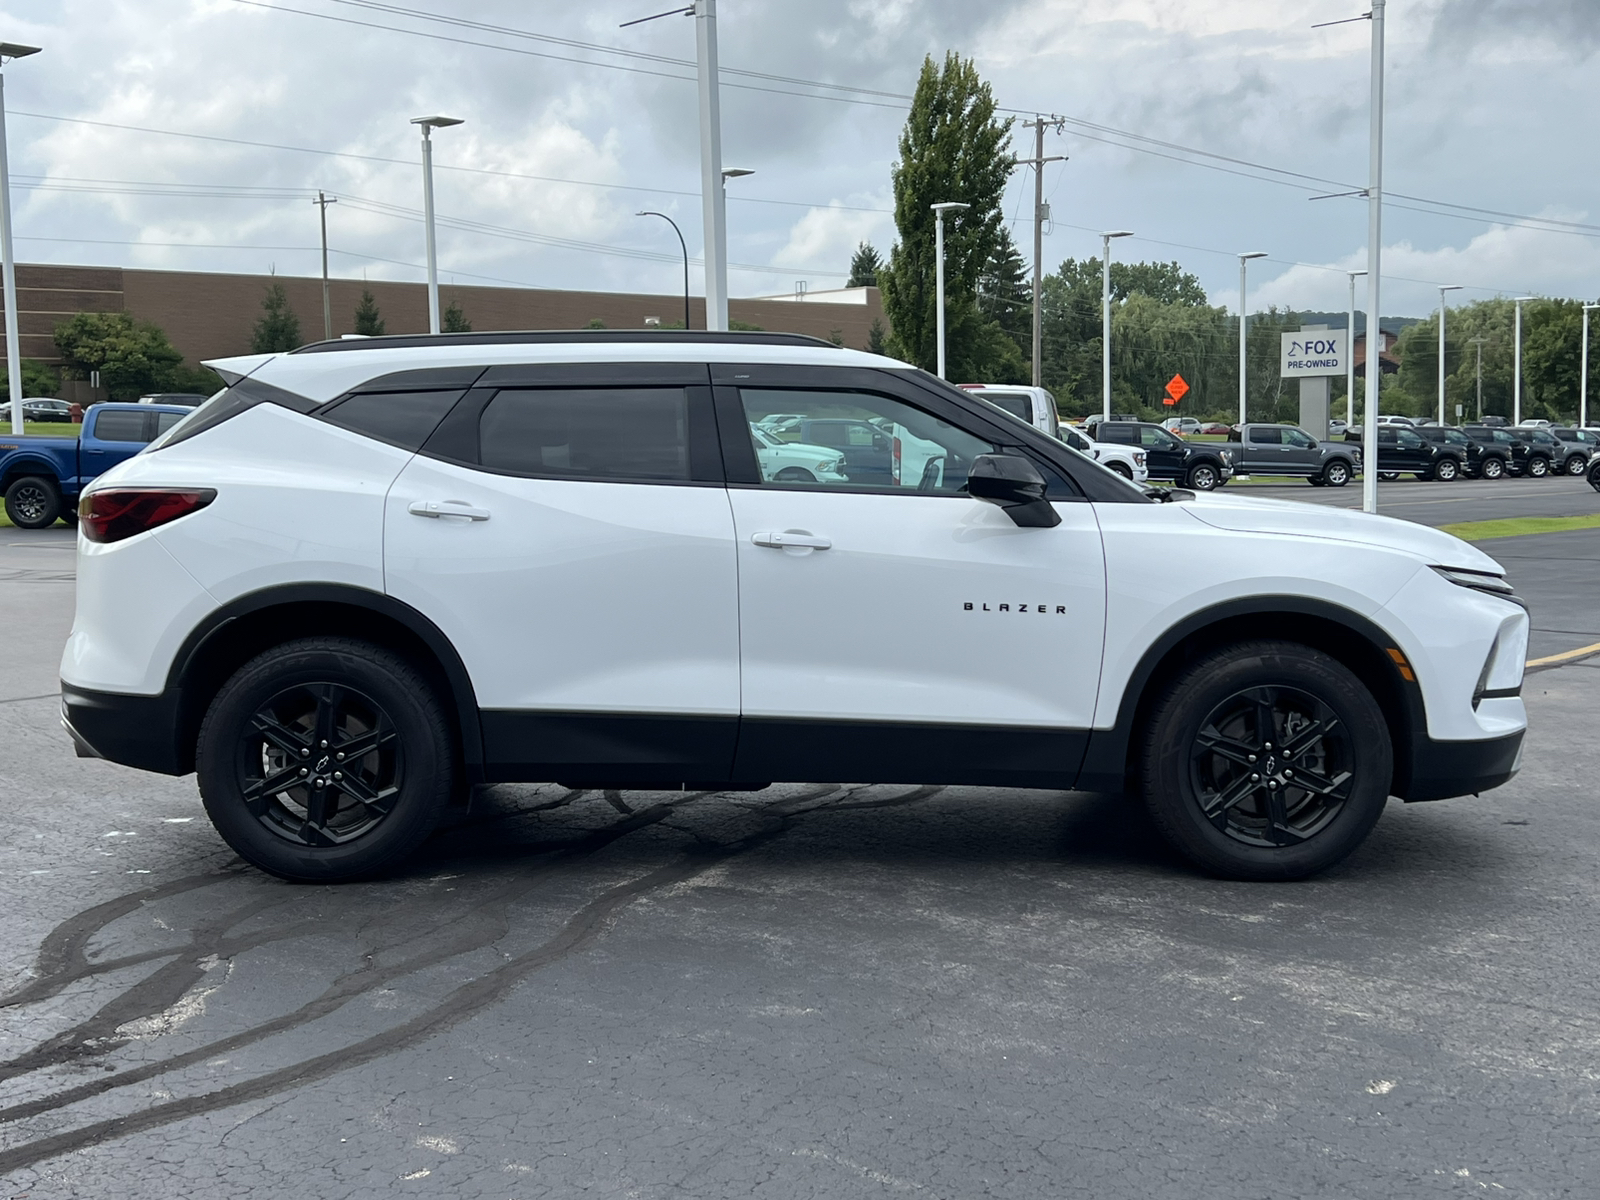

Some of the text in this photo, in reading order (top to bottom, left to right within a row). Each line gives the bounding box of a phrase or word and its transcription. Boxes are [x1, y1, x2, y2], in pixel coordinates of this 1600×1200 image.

[1304, 340, 1337, 355] FOX
[1287, 359, 1338, 369] PRE-OWNED
[963, 602, 1066, 614] BLAZER
